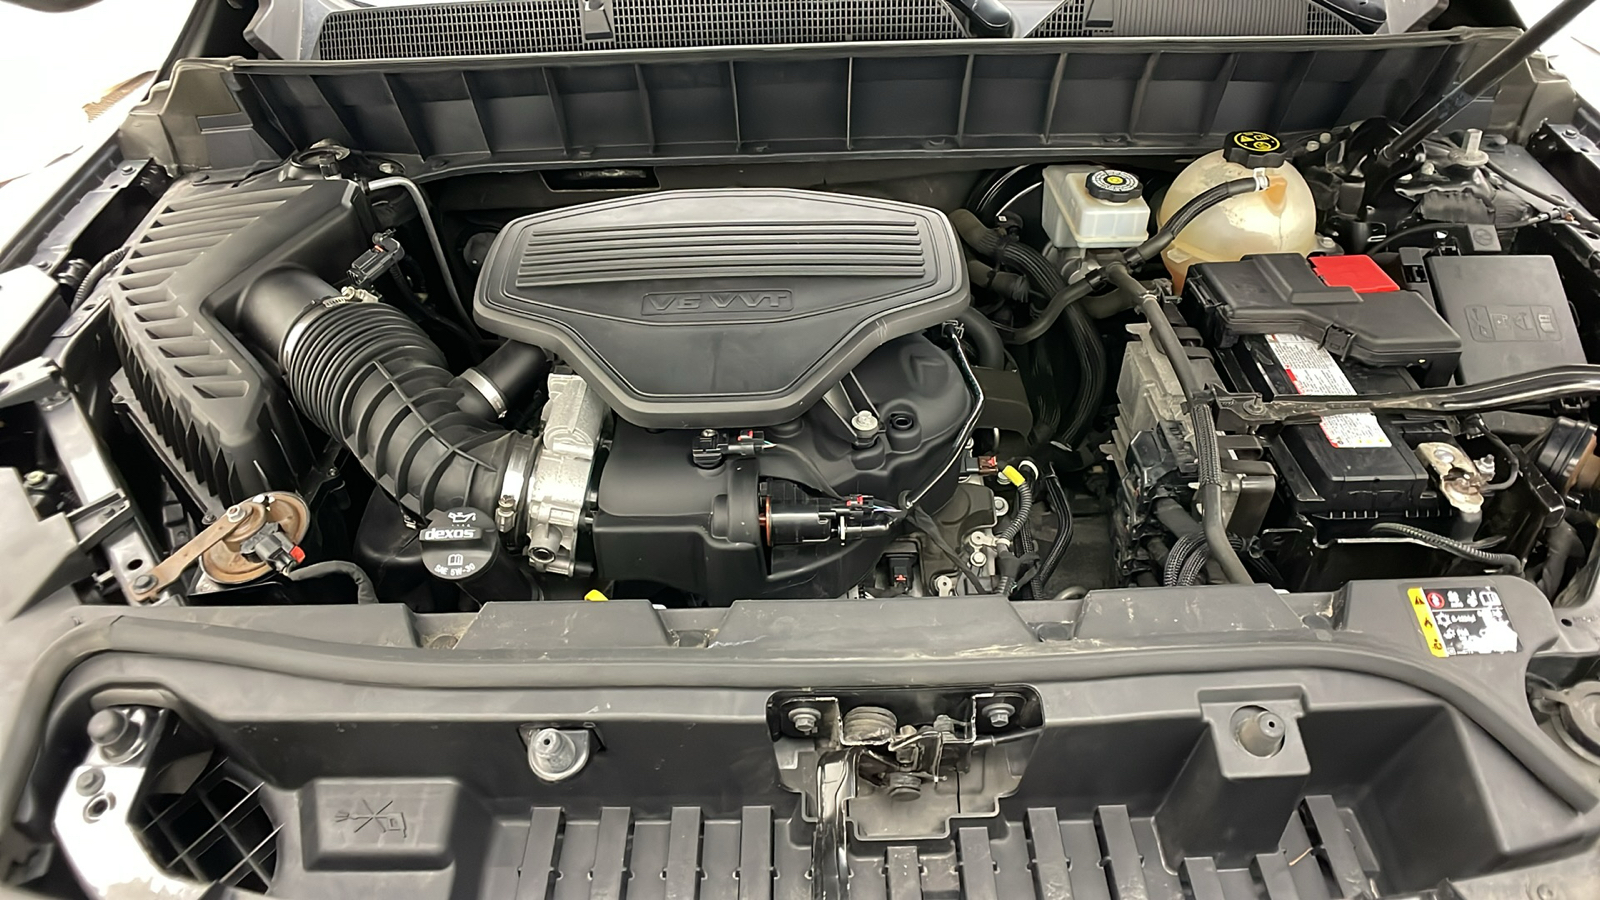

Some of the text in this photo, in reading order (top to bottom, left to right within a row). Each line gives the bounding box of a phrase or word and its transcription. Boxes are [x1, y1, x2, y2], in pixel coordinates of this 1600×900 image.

[650, 293, 788, 311] V6 VVT
[424, 527, 476, 540] dexos
[434, 562, 476, 576] SAE 5W-30
